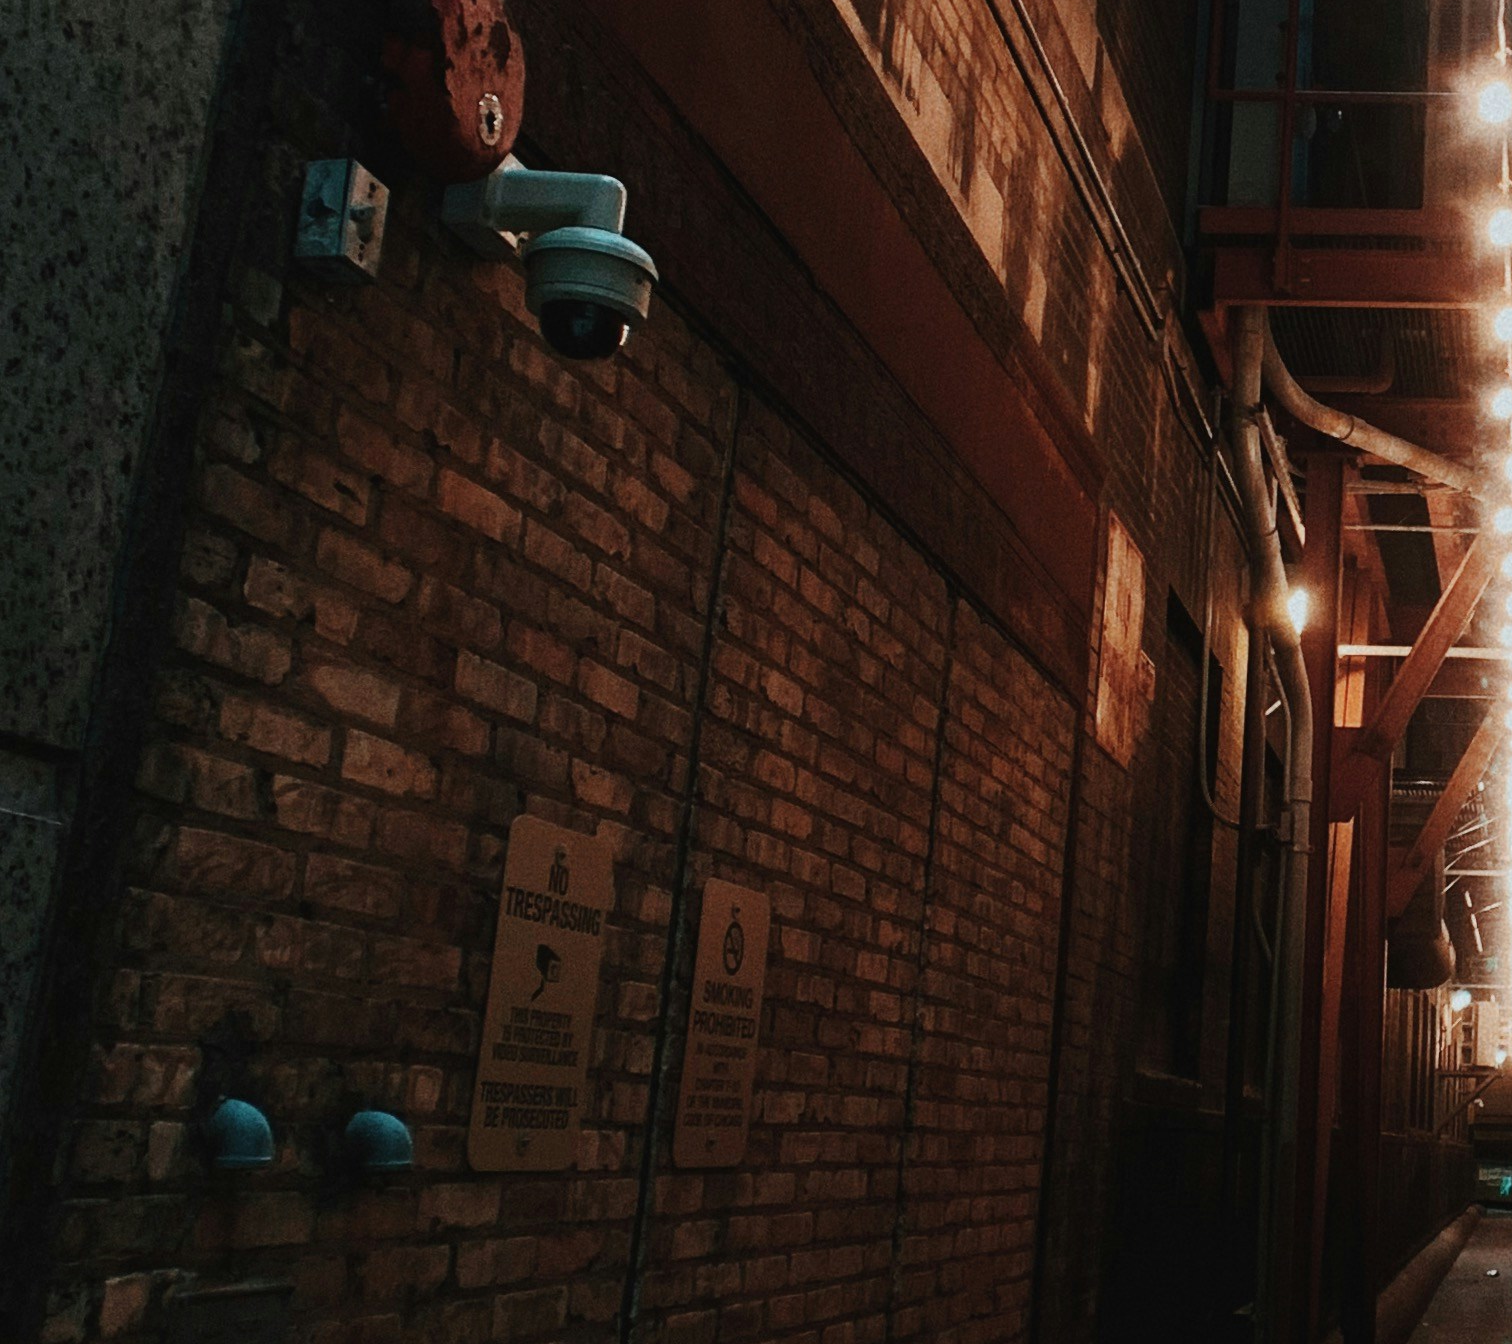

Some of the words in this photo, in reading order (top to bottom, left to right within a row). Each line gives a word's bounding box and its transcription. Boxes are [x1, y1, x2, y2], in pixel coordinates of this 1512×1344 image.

[548, 865, 569, 895] NO
[506, 886, 601, 936] TRESPASSING
[702, 980, 754, 1009] SMOKING
[510, 1006, 529, 1023] THIS
[530, 1009, 572, 1029] PROPERTY
[693, 1007, 756, 1039] PROHIBITED
[502, 1024, 512, 1042] IS
[513, 1026, 560, 1047] PROTECTED
[562, 1033, 574, 1048] BY
[492, 1042, 518, 1062] VIDEO
[480, 1081, 553, 1106] TRESPASSERS
[555, 1087, 578, 1108] WILL
[483, 1106, 500, 1127] BE
[501, 1107, 569, 1130] PROSECUTED
